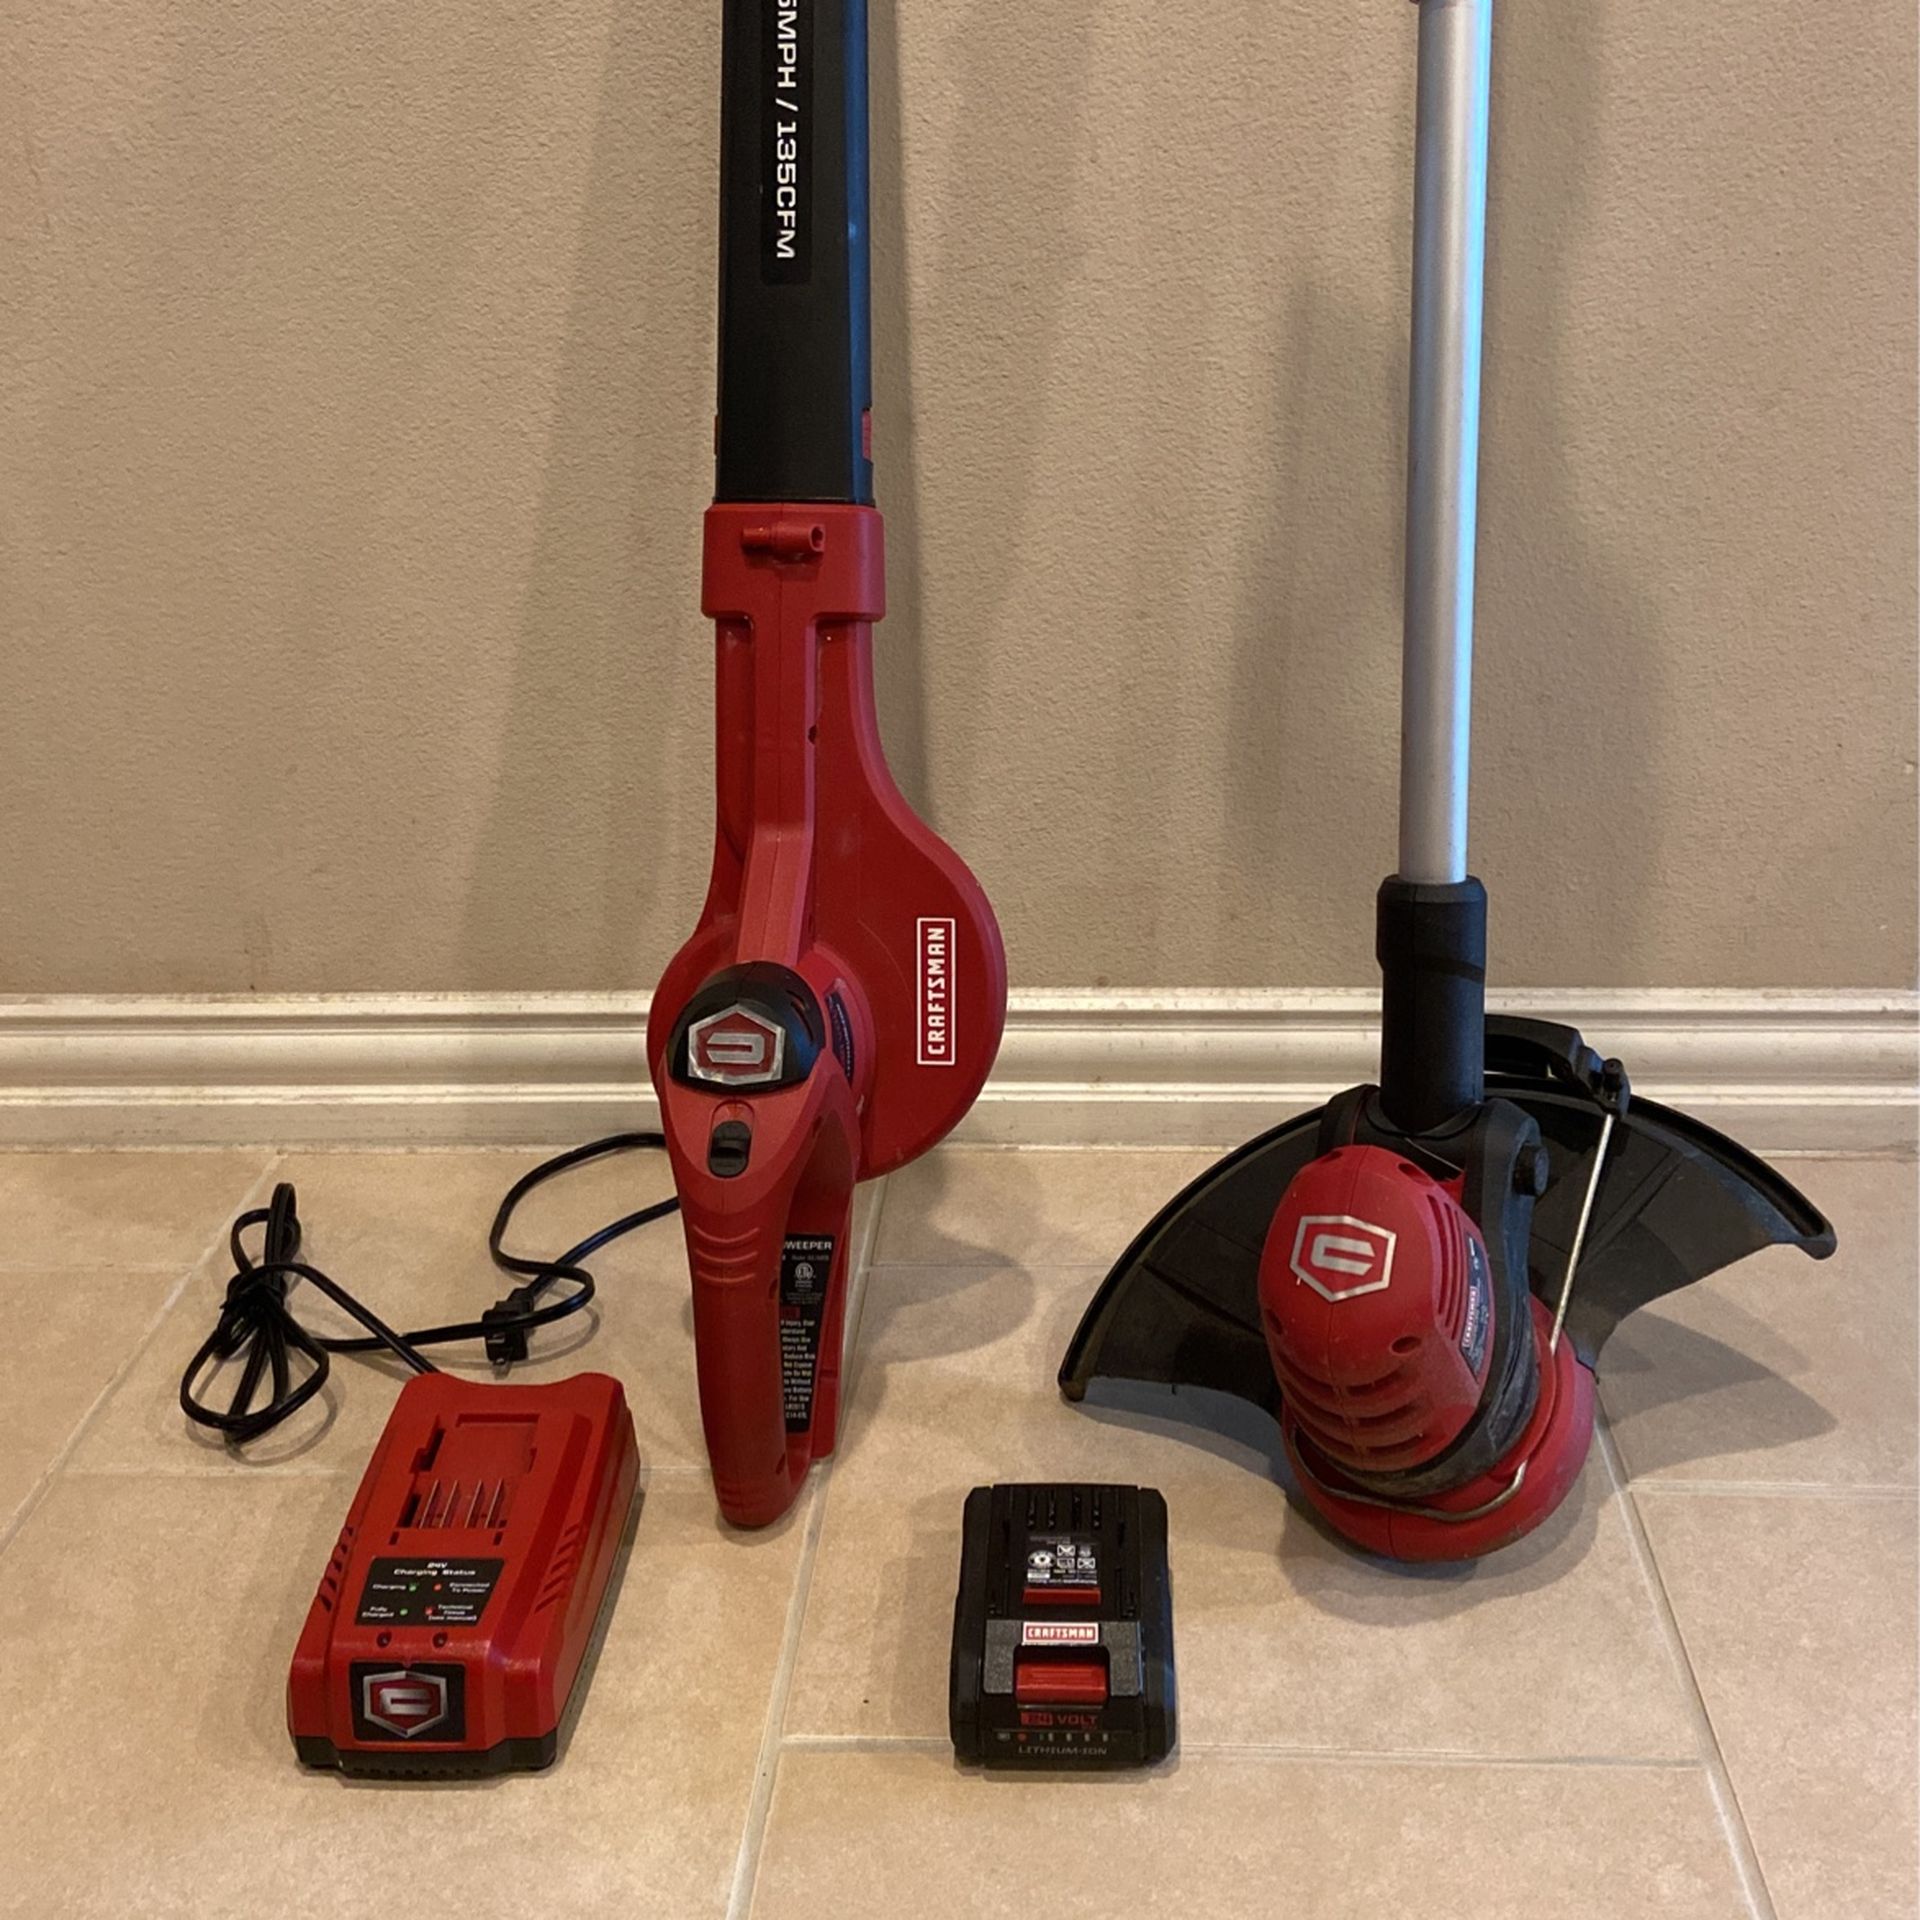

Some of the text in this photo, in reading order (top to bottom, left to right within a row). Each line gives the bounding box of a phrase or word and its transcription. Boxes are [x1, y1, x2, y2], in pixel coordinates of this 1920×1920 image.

[775, 98, 798, 112] /
[776, 121, 797, 259] 135CFM
[927, 927, 945, 1055] CRAFTSMAN
[393, 1568, 476, 1577] Charging Status
[1027, 1627, 1094, 1639] CRAFTSMAN
[1056, 1714, 1098, 1725] VOLT
[1018, 1745, 1108, 1756] LITHIUM-ION
